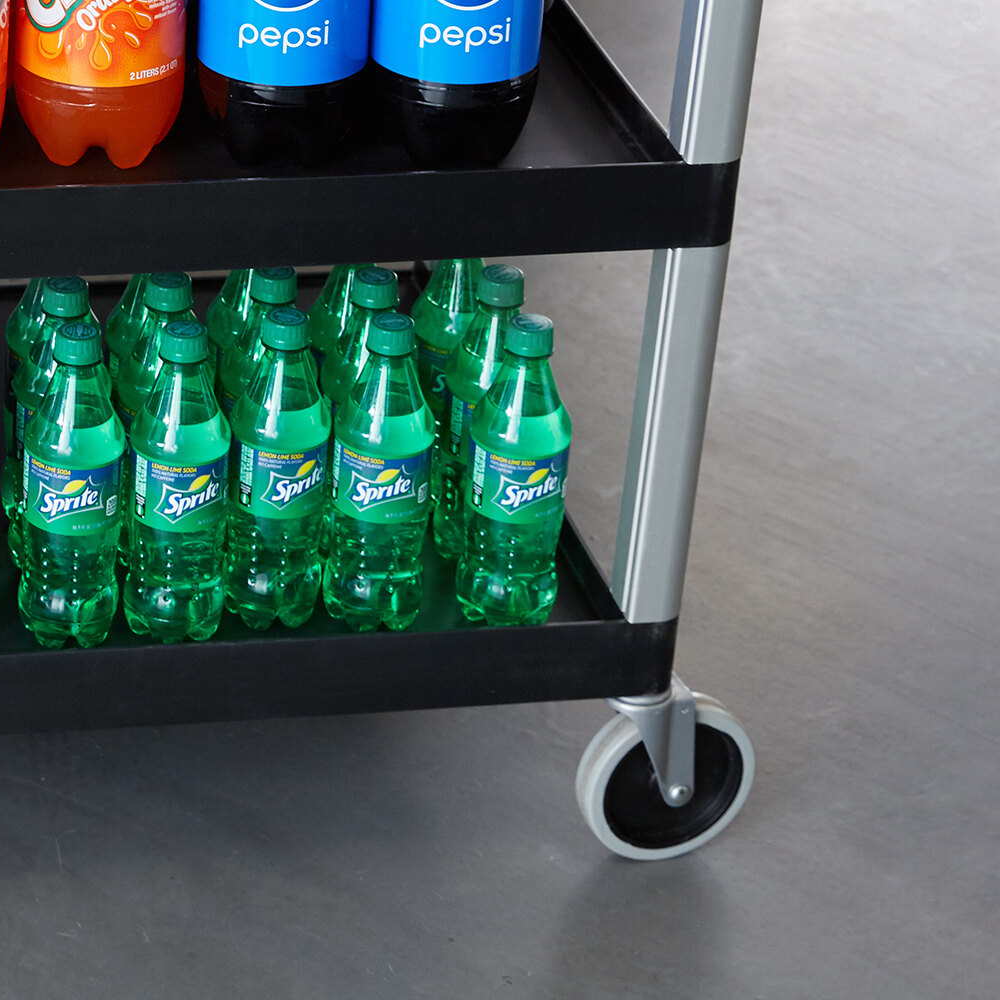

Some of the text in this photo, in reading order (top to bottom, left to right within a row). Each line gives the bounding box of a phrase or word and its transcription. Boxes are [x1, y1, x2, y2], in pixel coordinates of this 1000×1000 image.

[238, 20, 330, 54] pepsi
[419, 17, 511, 52] pepsi
[129, 71, 135, 81] 2
[135, 67, 159, 80] LITERS
[159, 62, 170, 75] (2.1
[258, 451, 289, 460] LEMON-LIME
[163, 480, 219, 517] Sprite
[271, 465, 323, 503] Sprite
[352, 475, 411, 506] Sprite
[500, 474, 558, 508] Sprite
[40, 487, 99, 517] Sprite
